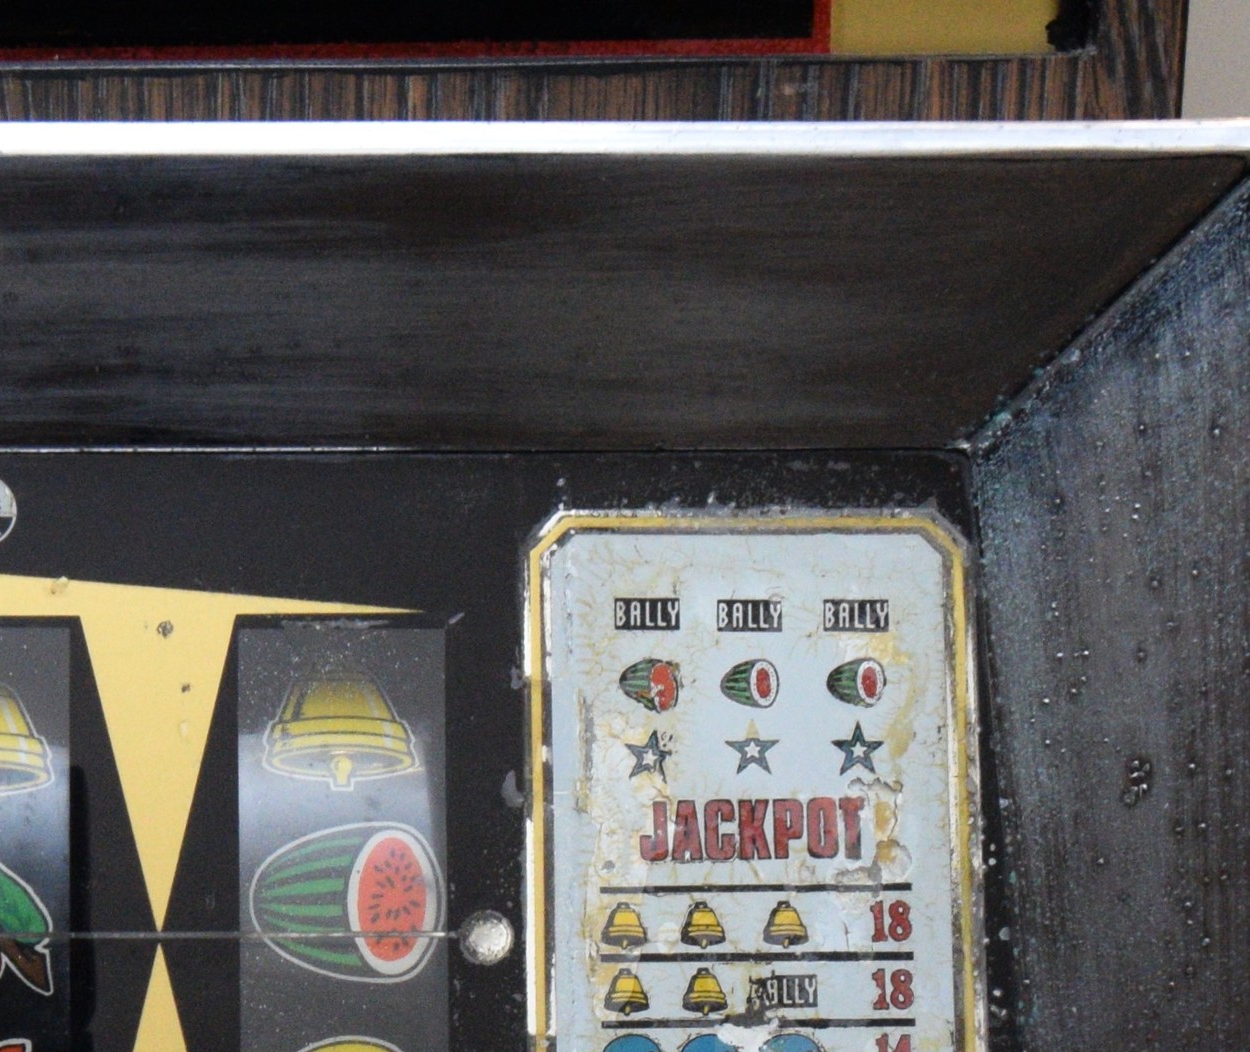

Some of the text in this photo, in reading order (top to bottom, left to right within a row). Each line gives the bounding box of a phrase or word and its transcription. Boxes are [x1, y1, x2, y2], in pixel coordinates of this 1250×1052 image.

[616, 601, 888, 629] BALLY BALLY BALLY
[639, 797, 866, 862] JACKPOT
[870, 900, 913, 943] 18
[871, 968, 915, 1010] 18
